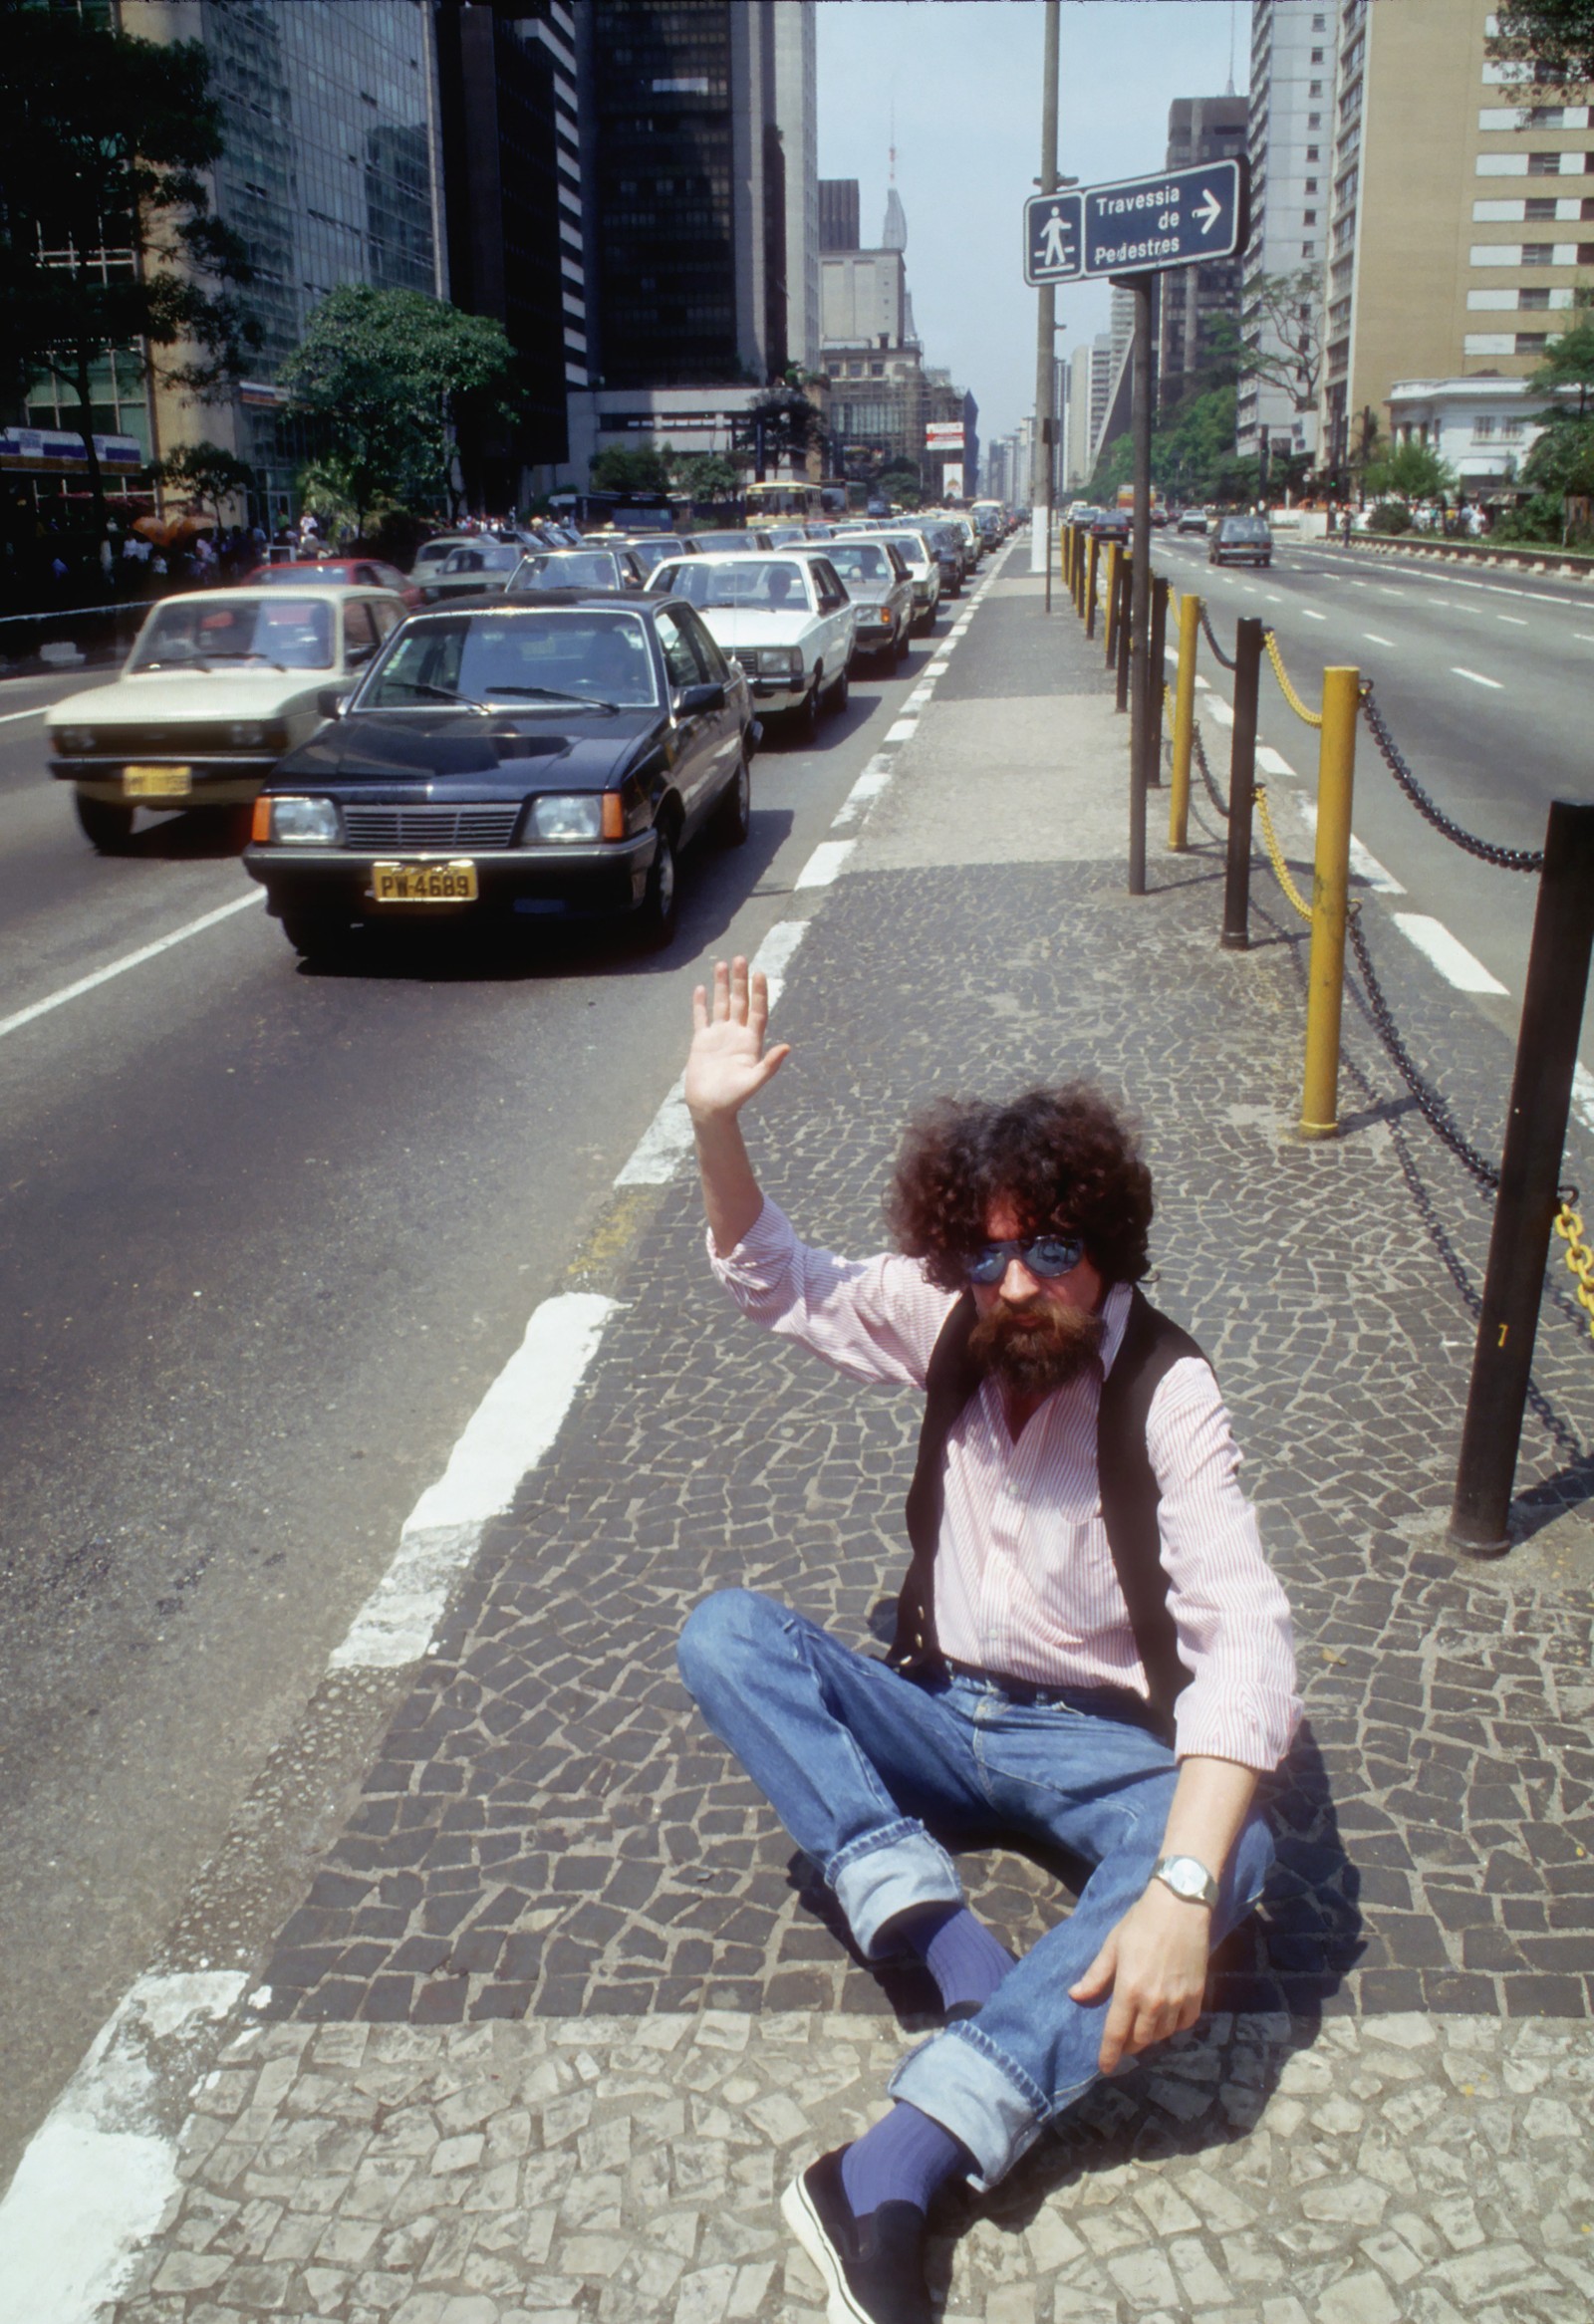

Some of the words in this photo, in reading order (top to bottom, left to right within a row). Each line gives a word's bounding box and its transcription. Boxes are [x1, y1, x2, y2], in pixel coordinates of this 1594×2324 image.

[1096, 186, 1180, 216] Travessia
[1158, 210, 1180, 230] de
[1095, 237, 1180, 265] Pedestres
